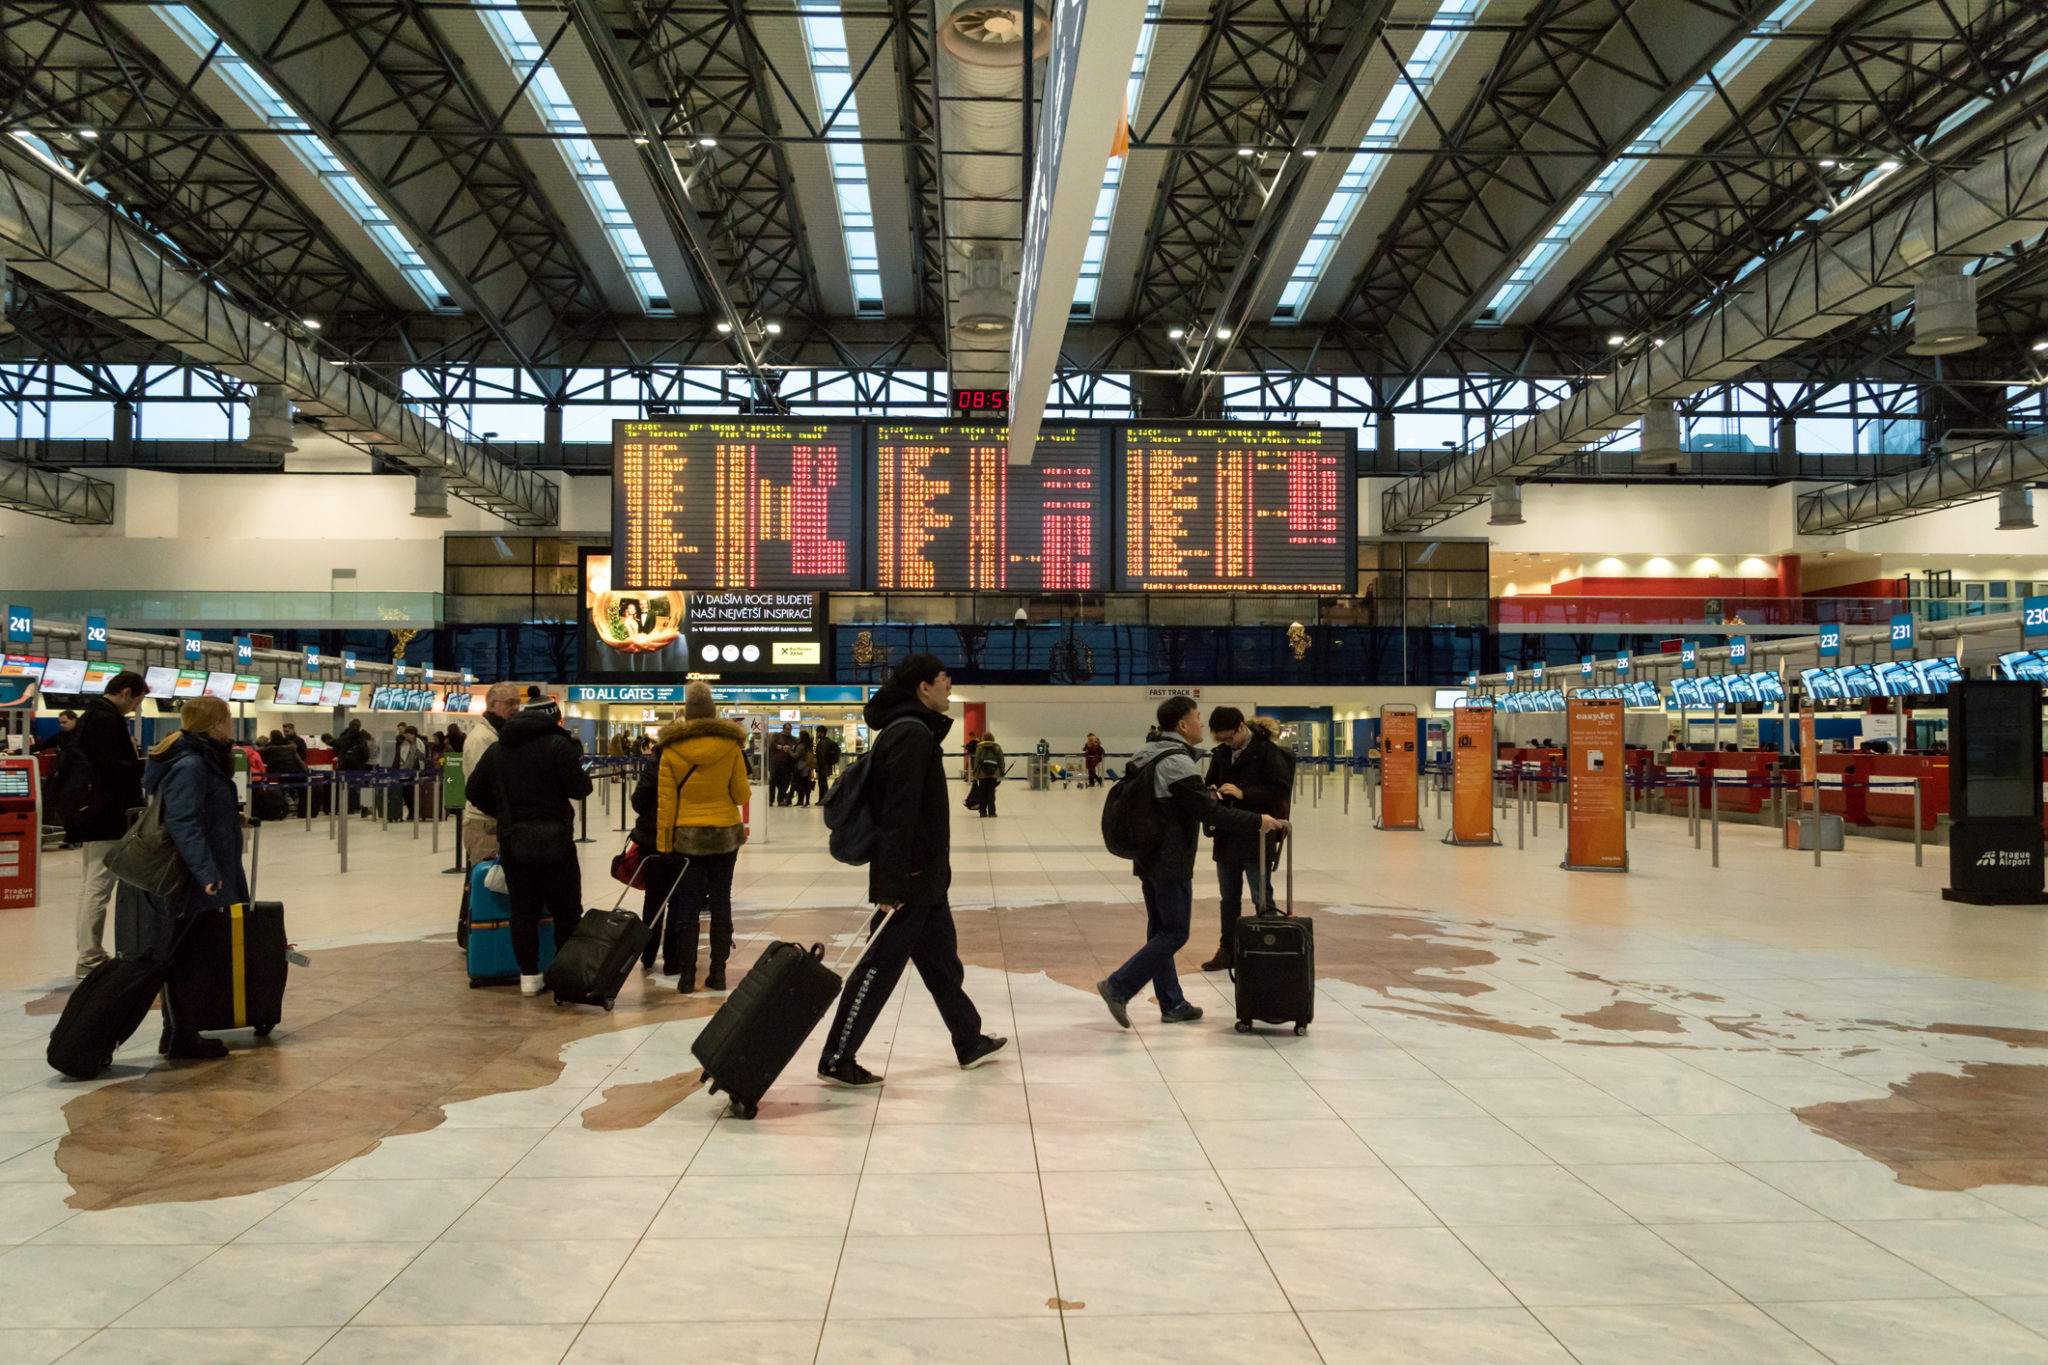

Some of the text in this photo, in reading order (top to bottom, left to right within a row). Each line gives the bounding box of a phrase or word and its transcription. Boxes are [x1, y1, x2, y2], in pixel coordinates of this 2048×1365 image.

[696, 595, 704, 605] V
[706, 593, 743, 605] DALŠÍM
[745, 595, 773, 605] ROCE
[776, 595, 813, 605] BUDETE
[691, 607, 812, 620] NAŠÍ NEJVĚTŠÍ INSPIRACÍ
[2026, 607, 2048, 626] 230
[10, 616, 31, 633] 241
[87, 626, 106, 642] 242
[1892, 624, 1911, 640] 231
[185, 638, 201, 652] 243
[1821, 633, 1839, 648] 232
[238, 645, 252, 657] 244
[1682, 650, 1695, 662] 234
[1730, 644, 1745, 657] 233
[579, 688, 596, 700] TO
[596, 688, 618, 700] ALL
[619, 688, 654, 700] GATES
[1575, 711, 1616, 721] easyJet
[1999, 850, 2031, 860] Prague
[1999, 858, 2031, 867] Airport
[4, 892, 33, 900] Airport
